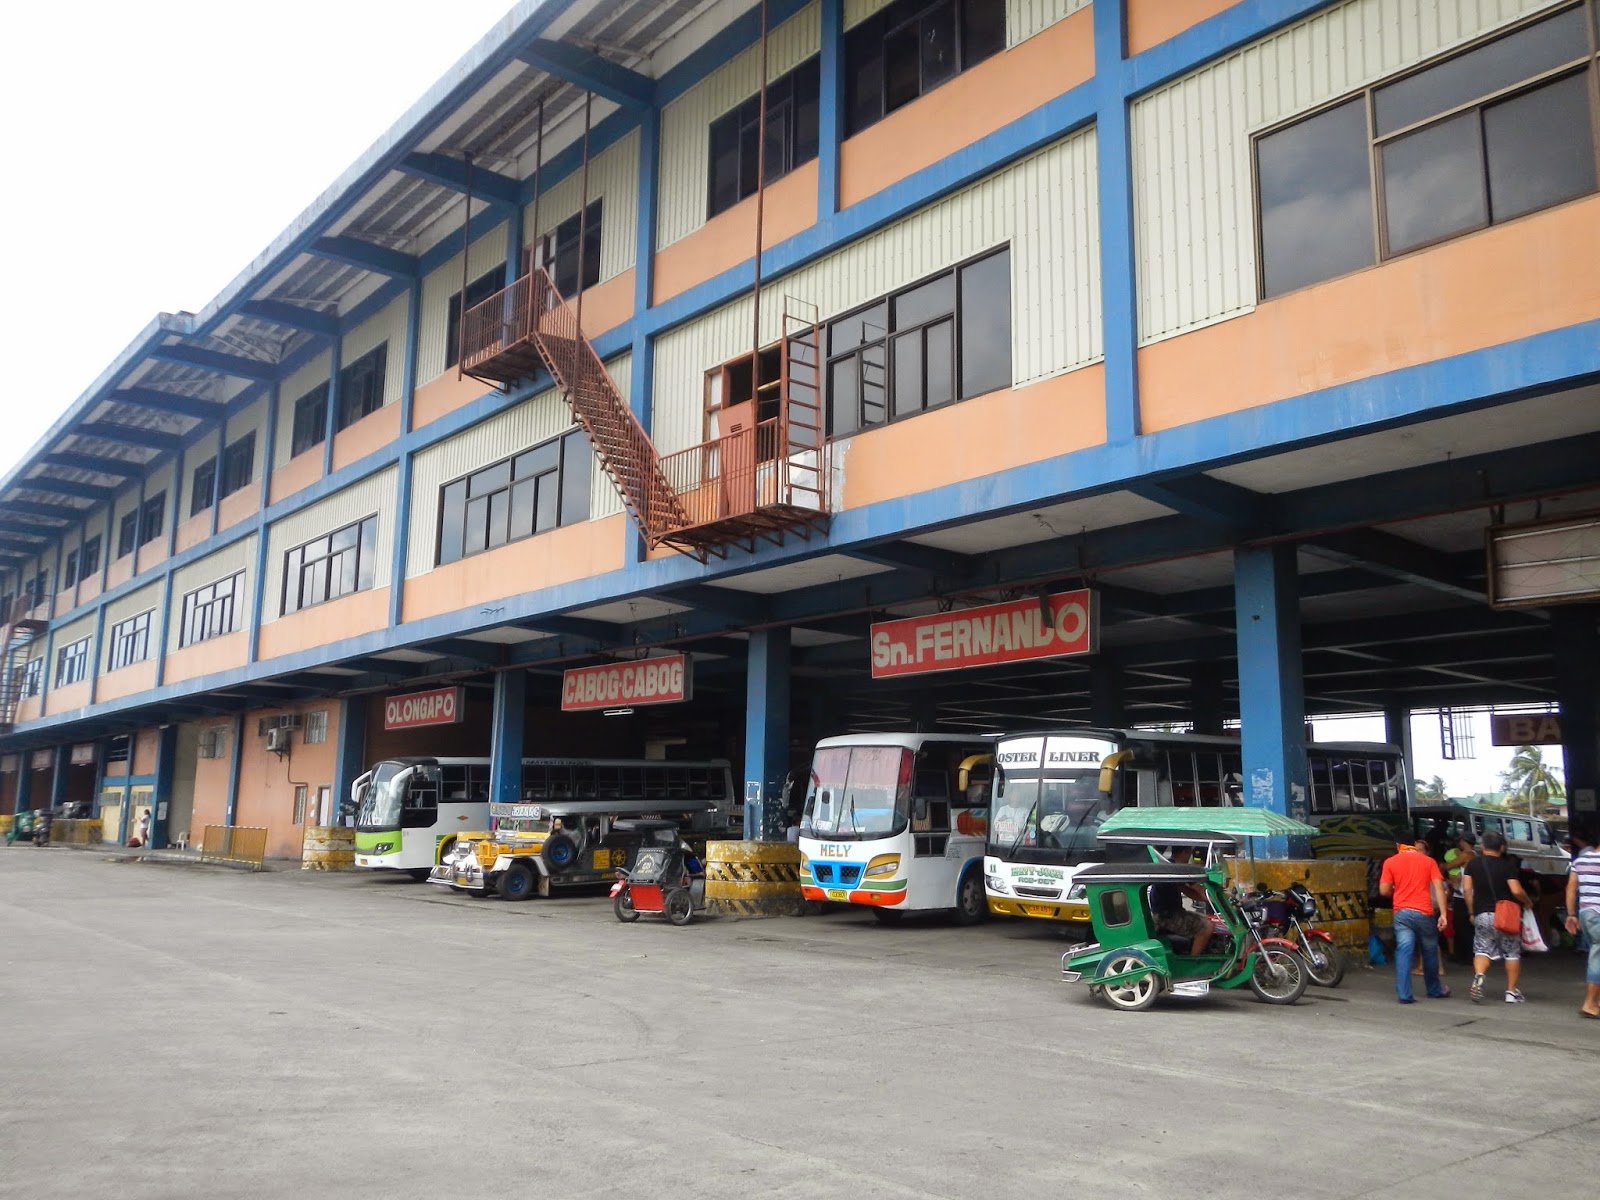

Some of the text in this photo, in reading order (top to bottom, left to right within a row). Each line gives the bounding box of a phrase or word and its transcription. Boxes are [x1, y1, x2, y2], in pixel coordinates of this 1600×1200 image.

[564, 661, 683, 704] CABOG-CABOG
[387, 693, 454, 724] OLONGAPO
[1048, 751, 1101, 762] LINER
